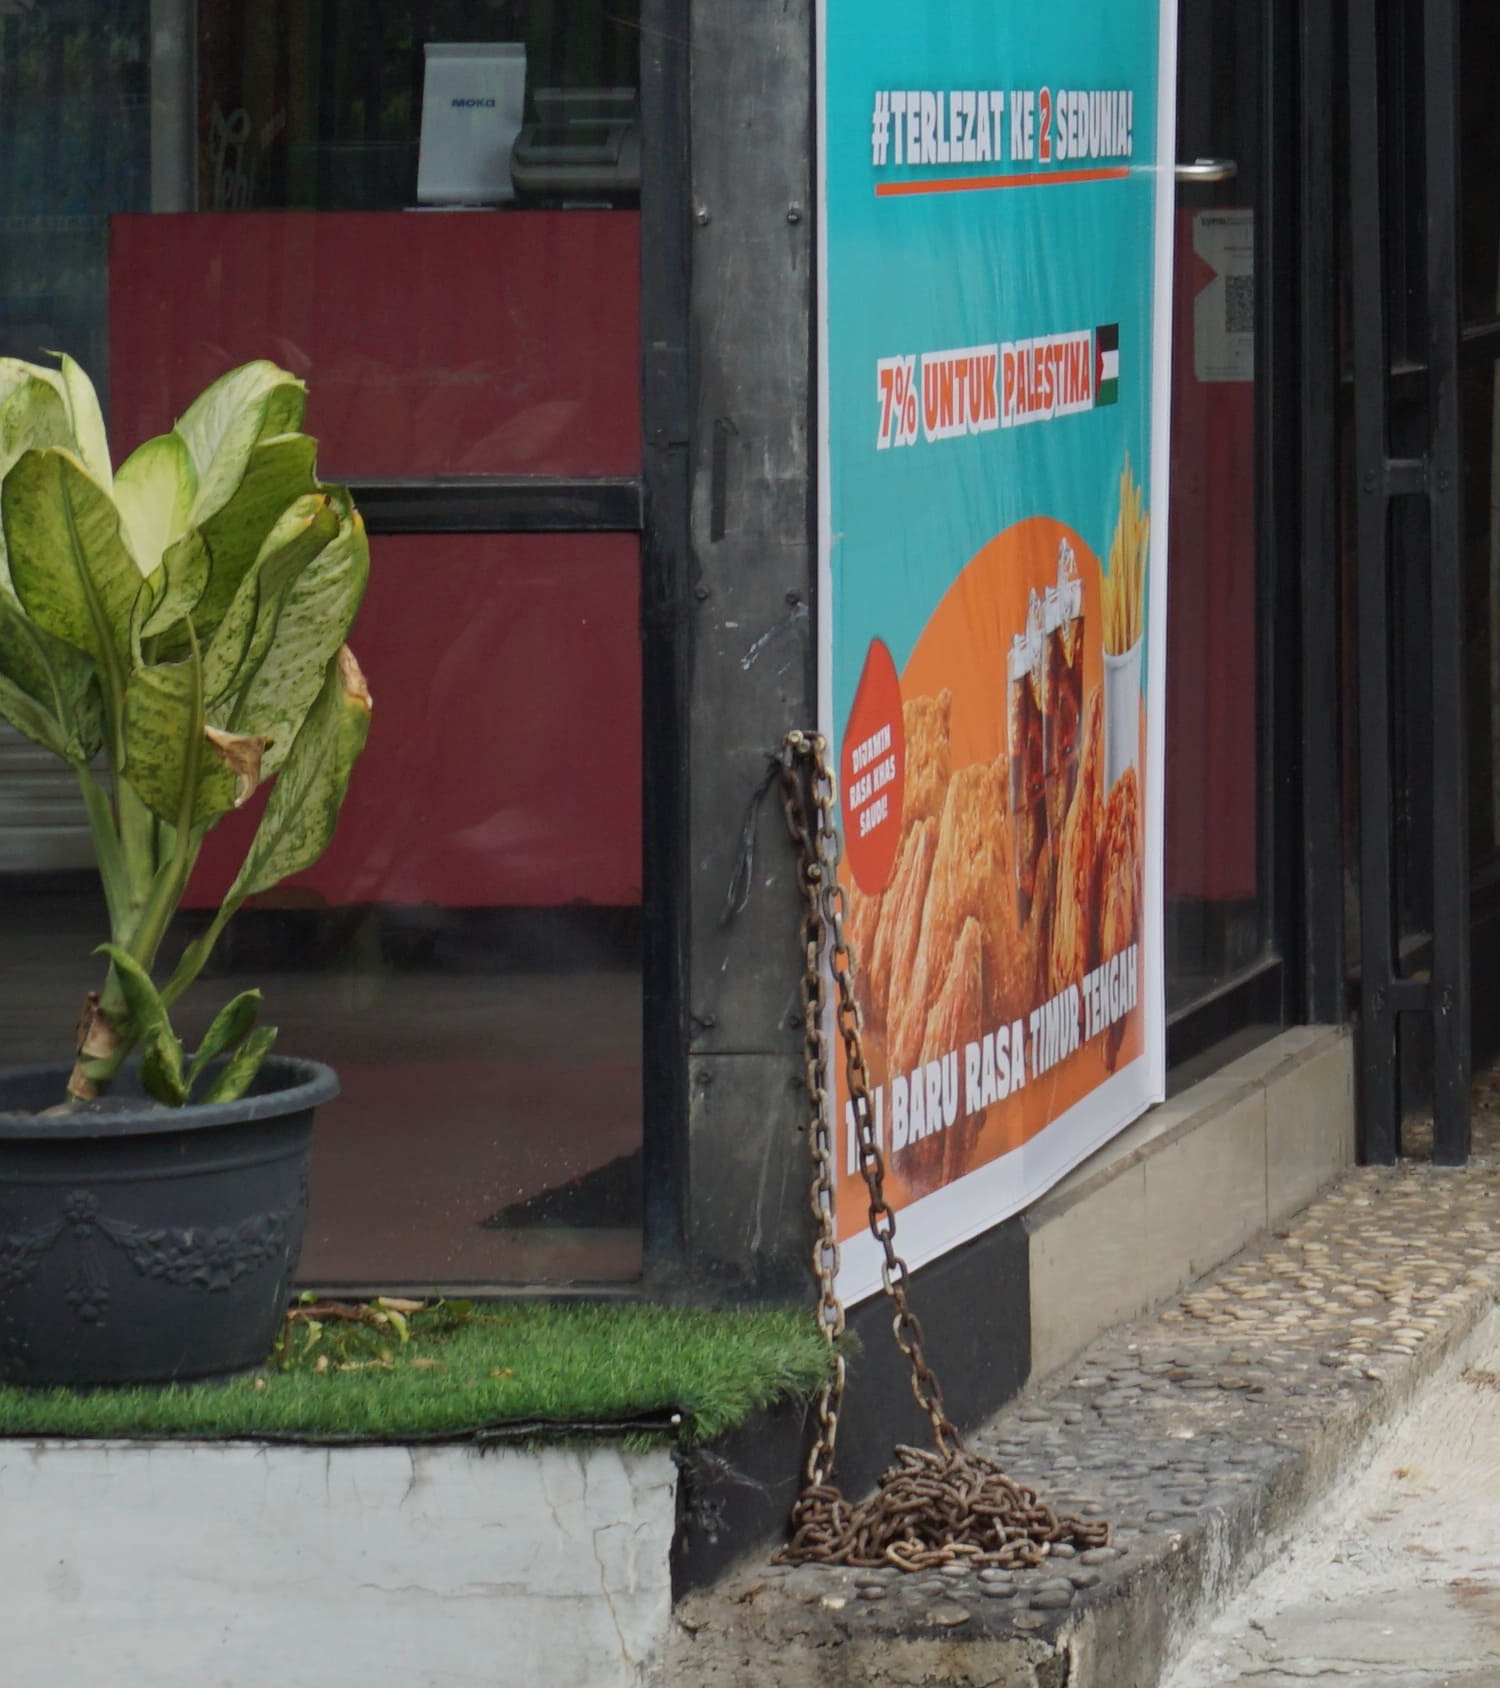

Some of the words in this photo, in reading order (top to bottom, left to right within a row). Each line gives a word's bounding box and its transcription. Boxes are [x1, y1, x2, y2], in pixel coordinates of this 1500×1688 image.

[872, 90, 1004, 166] #TERLEZAT
[1010, 90, 1034, 161] KE
[1038, 86, 1051, 162] 2
[1056, 88, 1133, 161] SEDUNIA!
[880, 360, 916, 438] 7%
[924, 353, 997, 432] UNTUK
[1003, 339, 1090, 417] PALESTINA
[891, 1050, 958, 1152] BARU
[965, 1018, 1026, 1115] RASA
[1030, 984, 1080, 1079] TIMUR
[1082, 944, 1138, 1042] TENGAH
